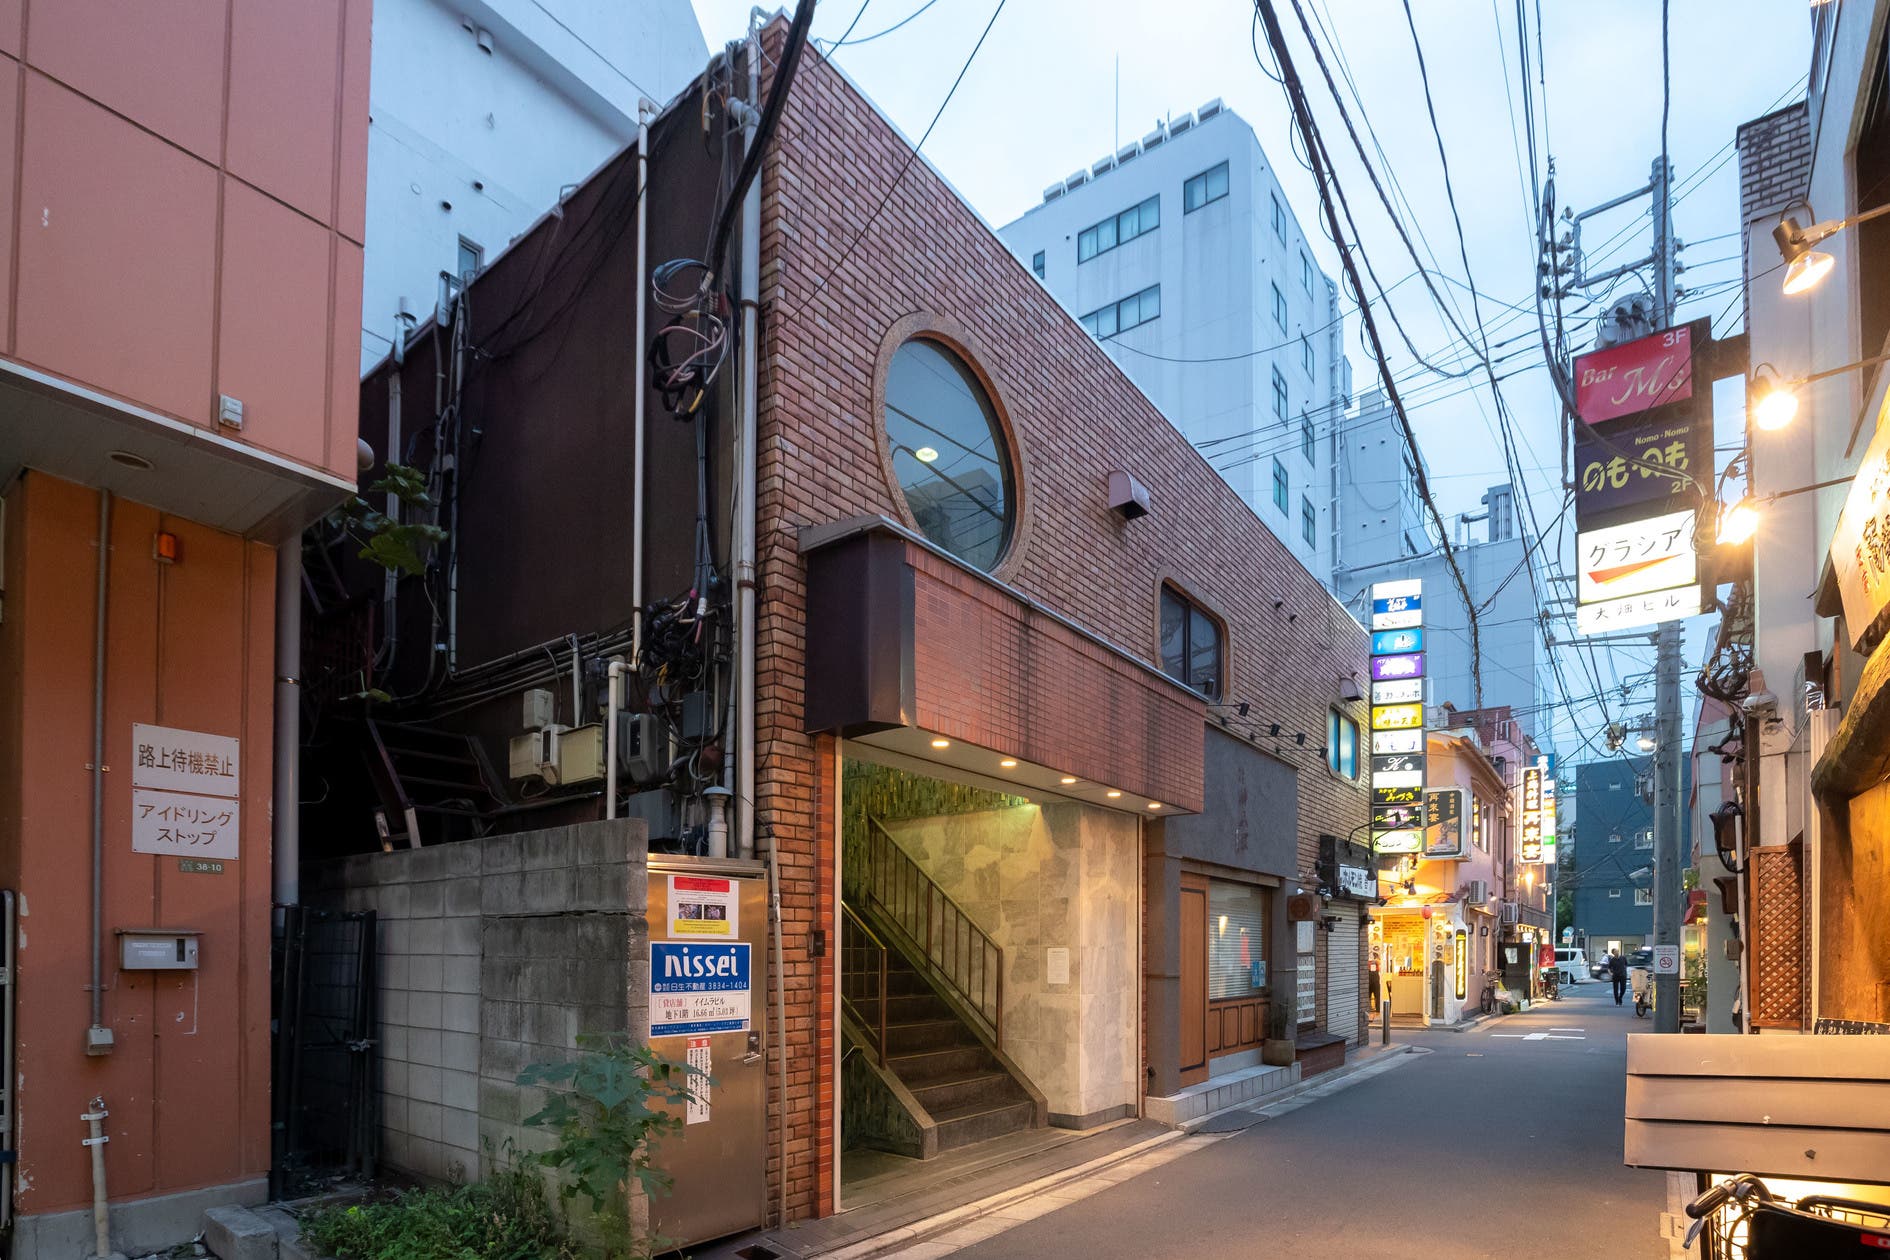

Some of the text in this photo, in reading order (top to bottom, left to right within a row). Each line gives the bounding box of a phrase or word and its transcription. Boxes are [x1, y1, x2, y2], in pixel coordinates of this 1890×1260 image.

[1663, 327, 1687, 348] 3F
[1581, 366, 1617, 387] Bar
[1671, 478, 1692, 493] 2F
[1590, 529, 1681, 567] グラシア
[138, 744, 234, 777] 路上待機禁止
[138, 804, 234, 827] アイドリング
[157, 828, 217, 845] ストップ
[665, 947, 738, 977] nissei
